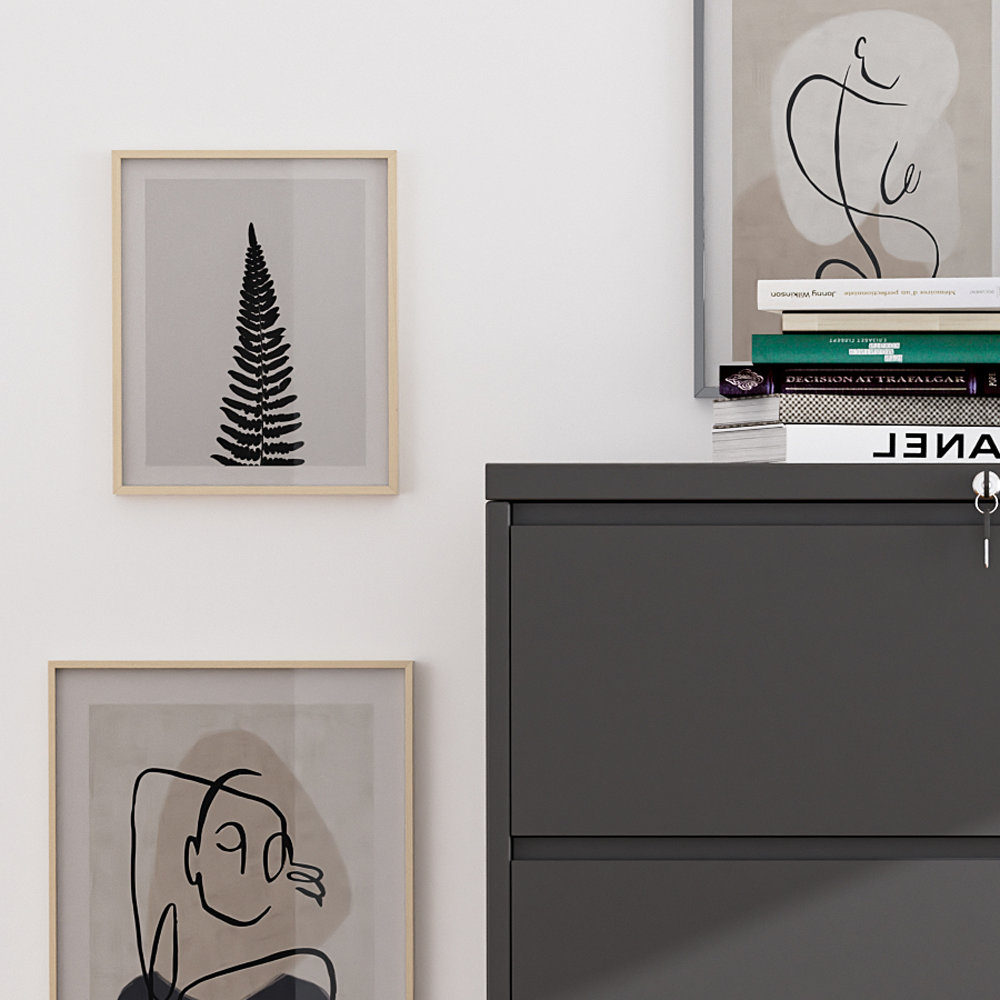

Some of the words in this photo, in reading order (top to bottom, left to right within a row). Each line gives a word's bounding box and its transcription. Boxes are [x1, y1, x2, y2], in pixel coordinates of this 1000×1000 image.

[770, 290, 811, 298] Wilkinson
[811, 289, 836, 298] Jonny
[785, 375, 853, 384] DECISION
[855, 375, 873, 383] AT
[874, 375, 966, 384] TRAFALGAR
